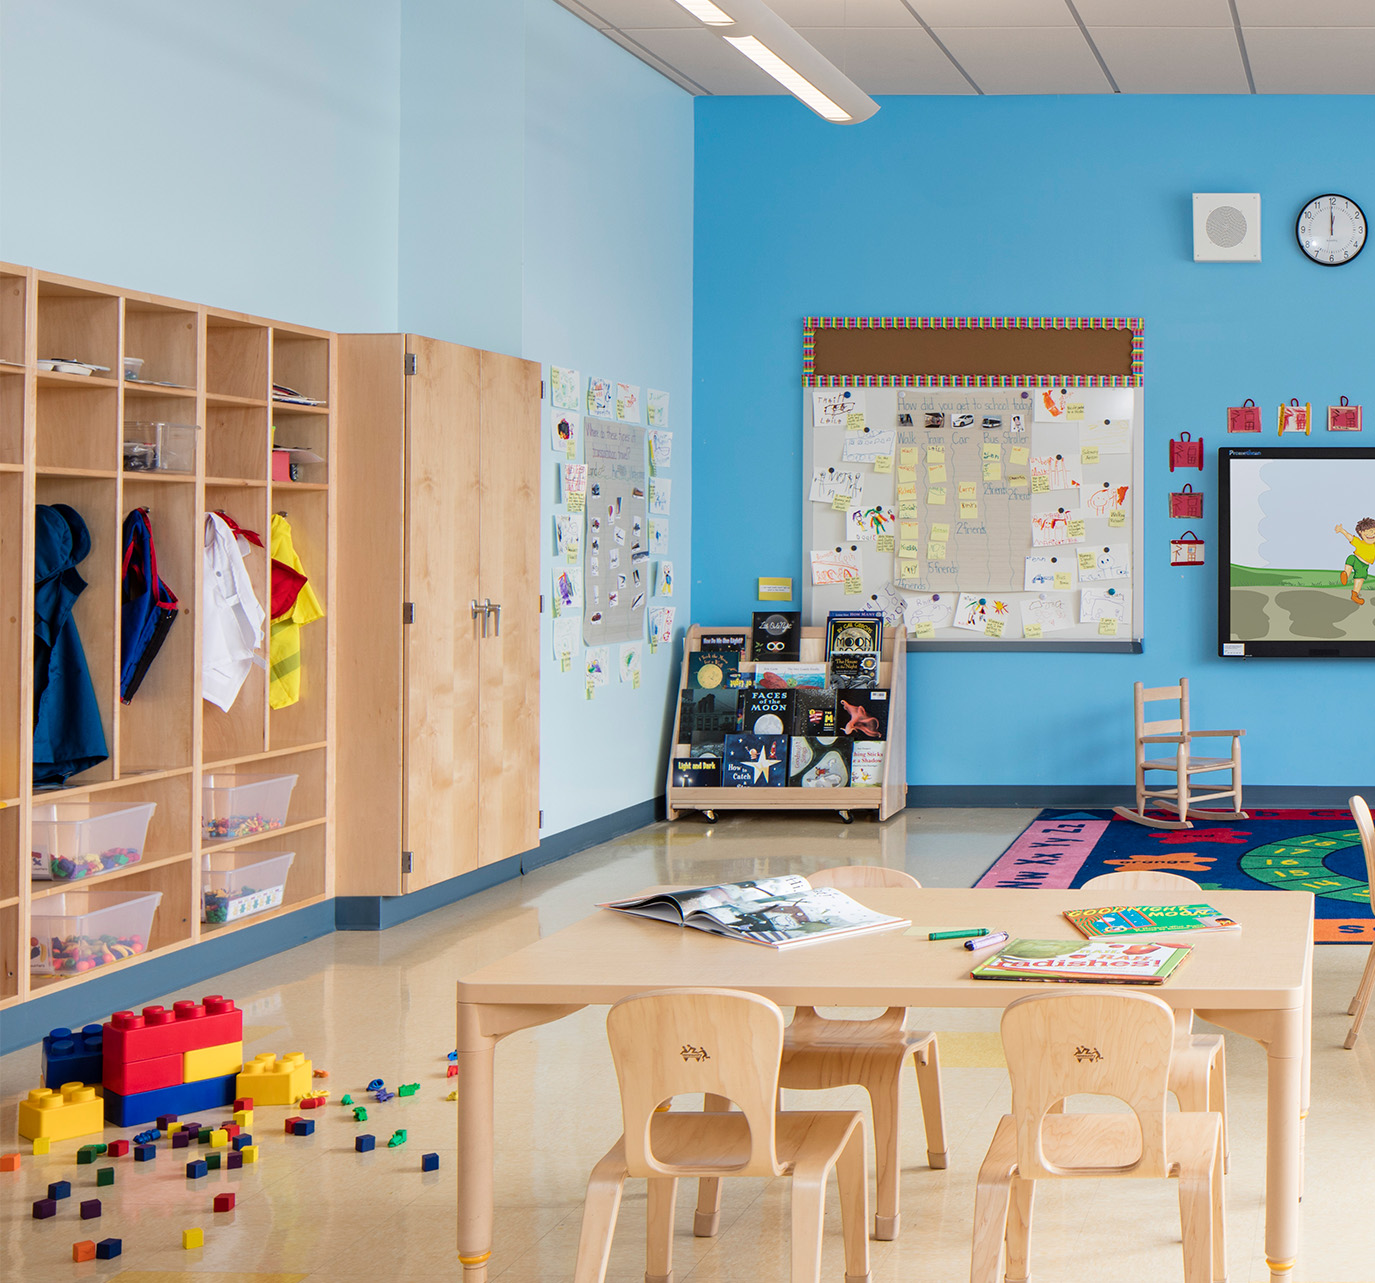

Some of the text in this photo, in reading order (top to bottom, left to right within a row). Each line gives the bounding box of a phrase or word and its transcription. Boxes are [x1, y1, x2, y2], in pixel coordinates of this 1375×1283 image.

[1329, 197, 1336, 206] 12
[1304, 211, 1312, 219] 10
[1355, 211, 1360, 219] 2
[1344, 251, 1349, 259] 5
[898, 398, 916, 410] How
[921, 398, 934, 410] did
[938, 402, 953, 413] you
[956, 400, 970, 414] get
[974, 399, 981, 410] to
[984, 398, 1009, 410] school
[897, 432, 1028, 444] Walk Train Car Bus Stroller
[837, 637, 872, 647] MOON
[678, 762, 691, 771] Light
[1300, 839, 1337, 847] 18
[1014, 853, 1063, 865] Xx
[1274, 869, 1310, 878] 15
[1301, 879, 1342, 889] 14
[1068, 905, 1190, 917] GOODNIGHT
[994, 959, 1161, 968] radishes!
